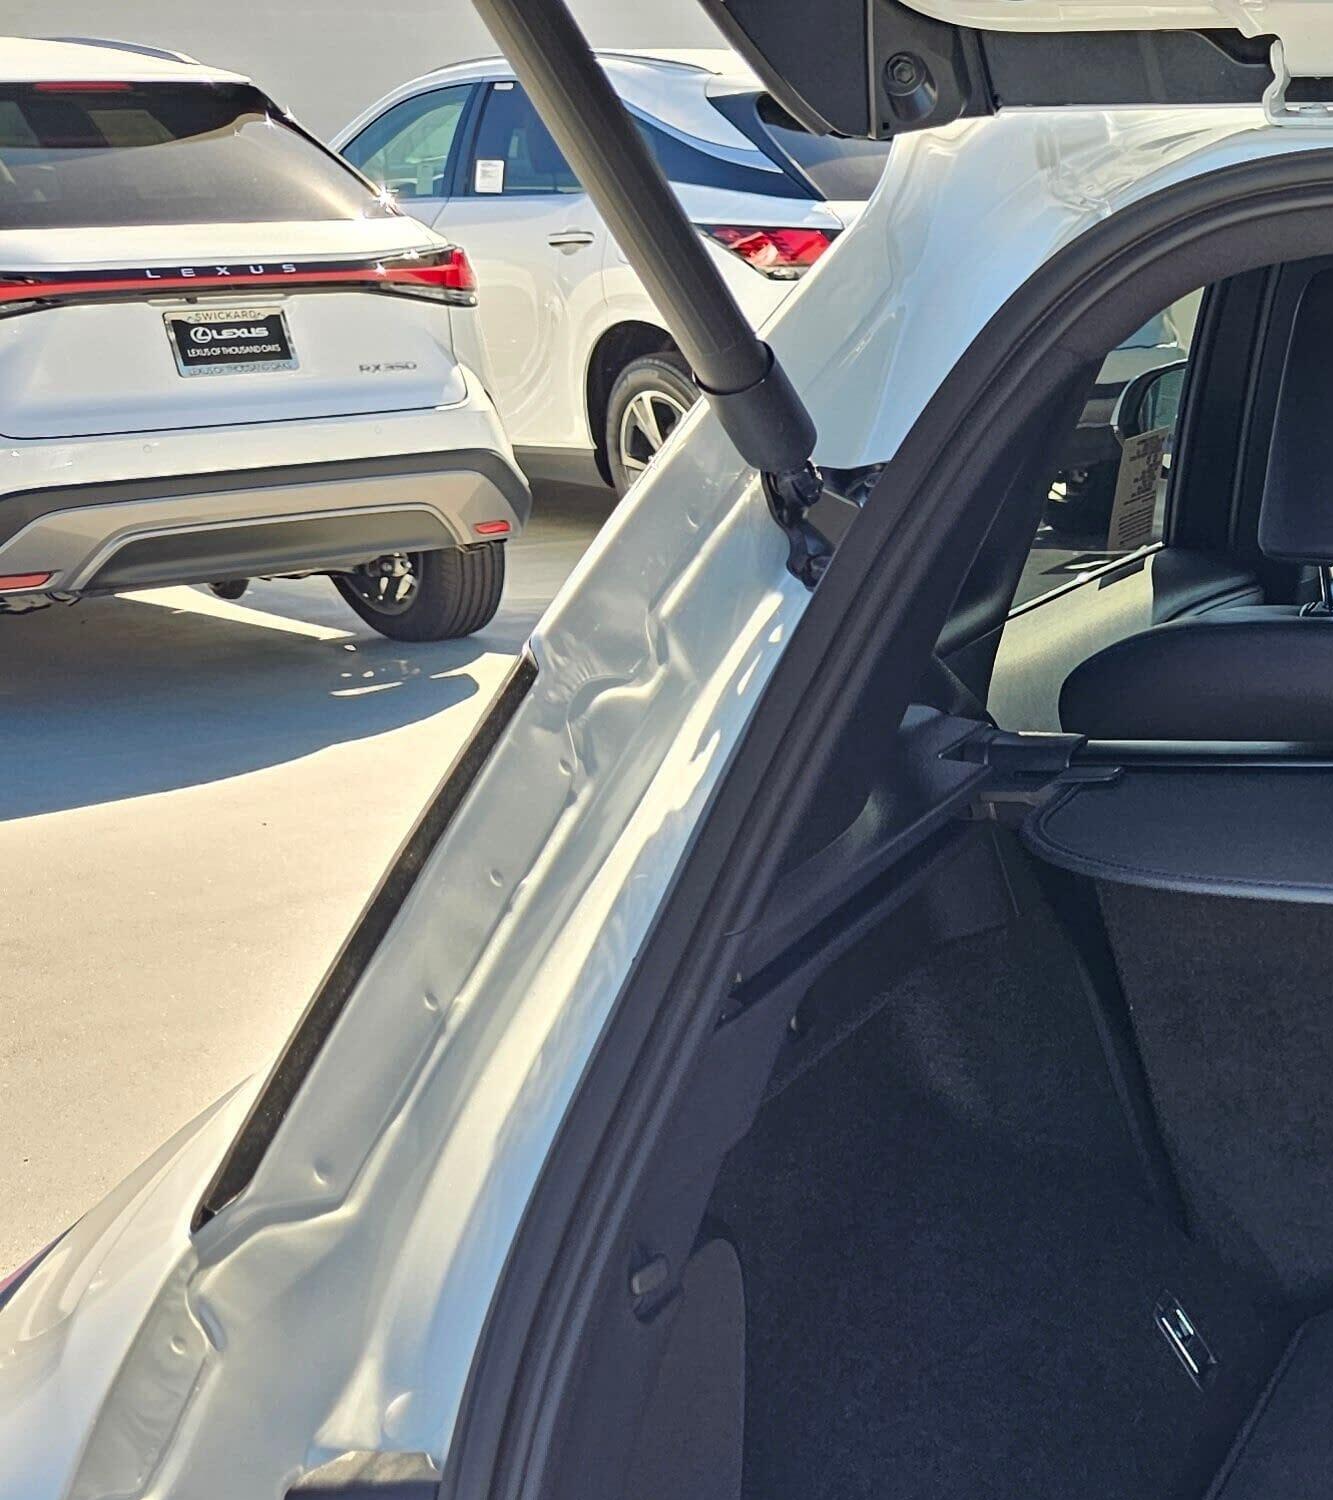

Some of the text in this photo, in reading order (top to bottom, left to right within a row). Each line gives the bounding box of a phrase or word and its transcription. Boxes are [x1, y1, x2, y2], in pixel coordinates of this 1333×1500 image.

[146, 264, 296, 279] LEXUS
[194, 310, 257, 322] SWICKARD
[212, 327, 269, 340] LEXUS
[187, 347, 211, 357] LEXUS
[221, 345, 260, 355] THOUSAND
